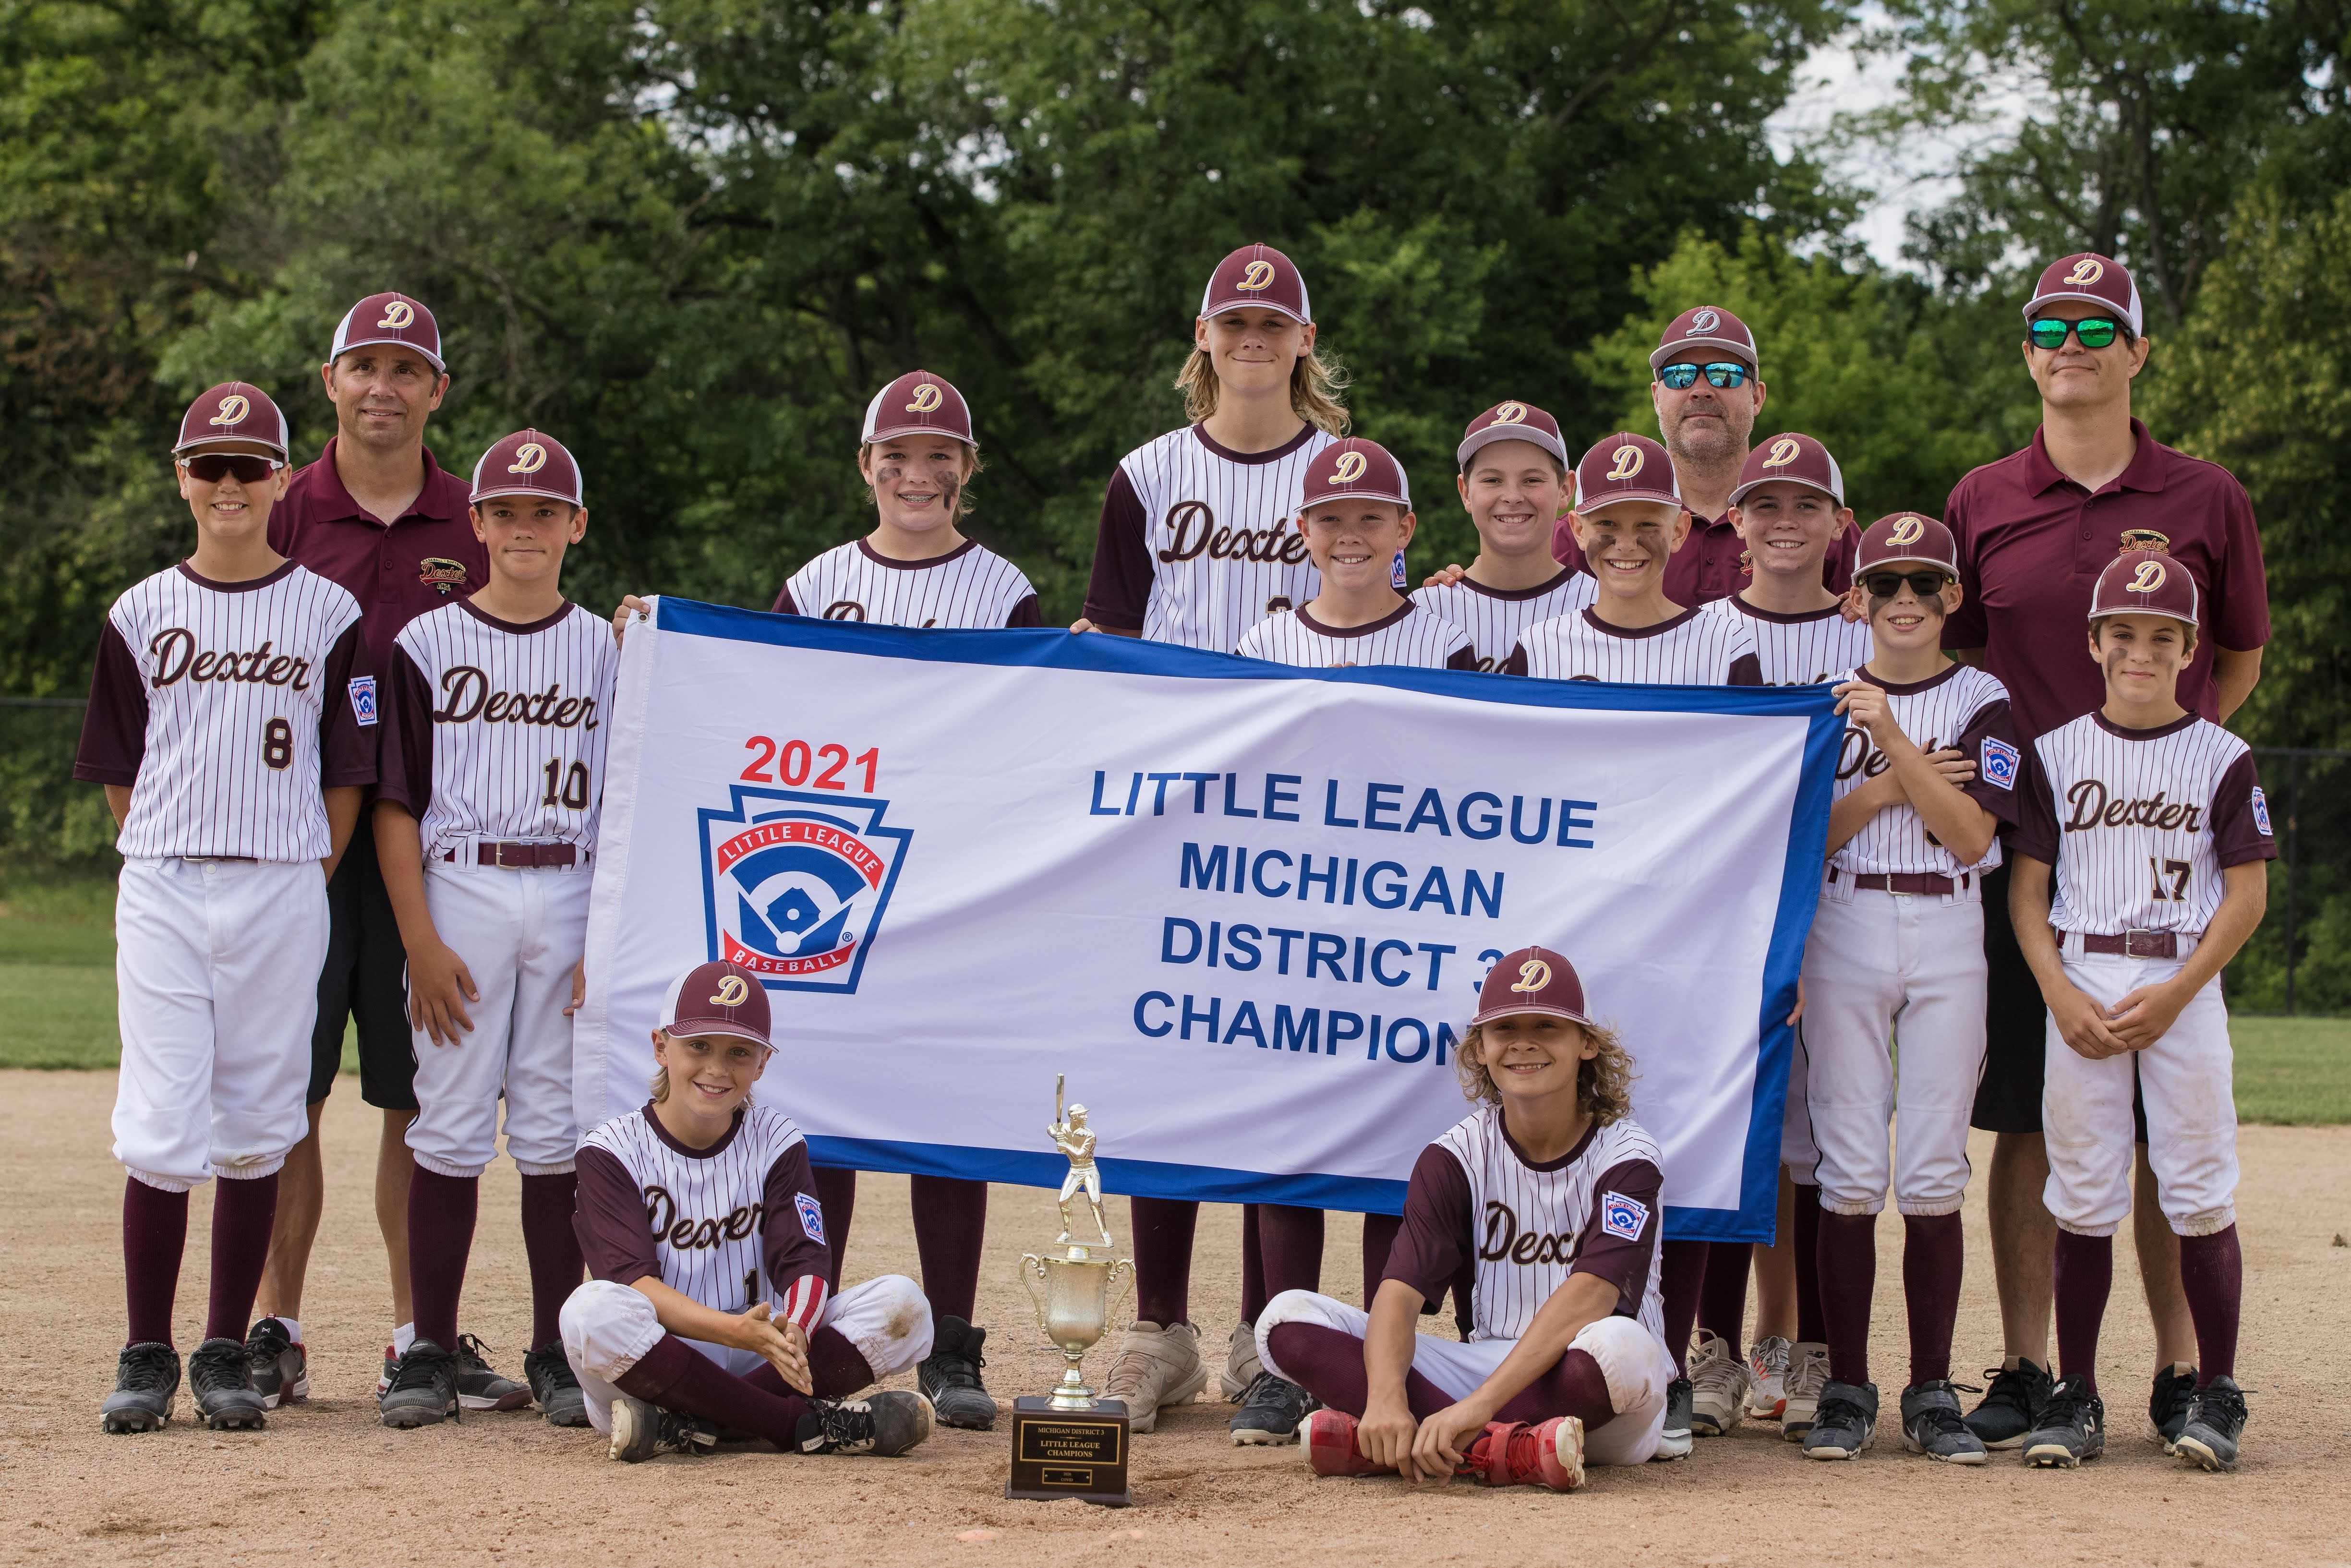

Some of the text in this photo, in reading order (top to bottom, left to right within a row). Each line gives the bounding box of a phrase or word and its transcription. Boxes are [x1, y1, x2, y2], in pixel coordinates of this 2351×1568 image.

[1237, 260, 1275, 291] D
[2063, 259, 2103, 286] D
[377, 301, 413, 328] D
[1686, 310, 1721, 336] D
[209, 395, 249, 425] D
[905, 384, 942, 412] D
[1490, 402, 1527, 423] D
[507, 443, 546, 473] D
[1329, 452, 1367, 484] D
[1606, 445, 1644, 480] D
[1762, 439, 1800, 468] D
[1158, 500, 1319, 569] Dexte
[1885, 517, 1924, 546] D
[2119, 534, 2170, 554] Dexter
[2148, 531, 2168, 542] SOFTBALL
[420, 563, 467, 581] Dexter
[446, 560, 465, 570] SOFTBALL
[2126, 561, 2166, 592] D
[150, 627, 310, 691] Dexter
[433, 665, 599, 731] Dexter
[262, 716, 293, 771] 8
[2001, 750, 2013, 763] LEAGUE
[739, 736, 879, 794] 2021
[1989, 771, 2008, 781] BASEBALL
[541, 757, 590, 811] 10
[1090, 770, 1597, 849] LITTLE LEAGUE
[2064, 779, 2200, 833] Dexter
[723, 825, 879, 873] LITTLE LEAGUE
[1180, 842, 1504, 918] MICHIGAN
[2149, 855, 2193, 902] 17
[732, 949, 841, 972] BASEBALL
[1161, 917, 1456, 991] DISTRICT
[709, 975, 749, 1006] D
[1511, 960, 1552, 992] D
[1133, 990, 1472, 1066] CHAMPION
[644, 1184, 764, 1251] Dexer
[1625, 1204, 1639, 1218] LEAGUE
[1479, 1200, 1585, 1266] Dex
[1610, 1223, 1633, 1232] BASEBALL
[1047, 1449, 1093, 1458] CHAMPIONS
